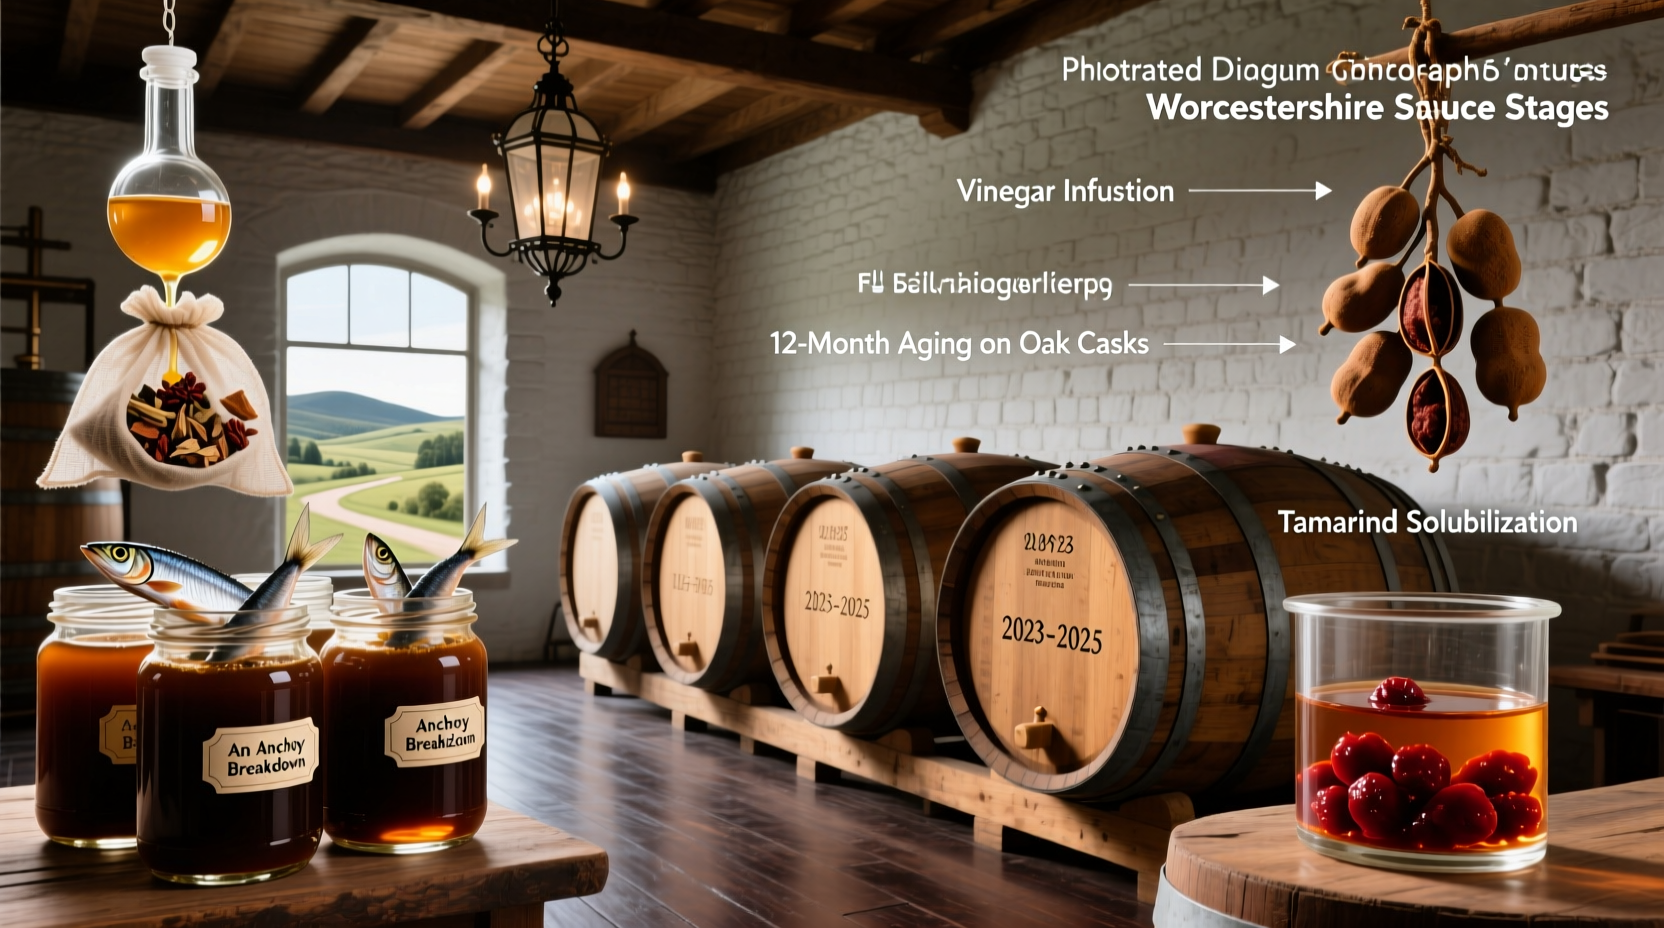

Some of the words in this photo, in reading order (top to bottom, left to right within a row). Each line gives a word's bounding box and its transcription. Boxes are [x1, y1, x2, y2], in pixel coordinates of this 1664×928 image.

[1002, 614, 1102, 655] 2023-2025
[416, 714, 469, 733] Anchoy
[227, 742, 251, 757] An
[227, 756, 306, 777] Breakdown
